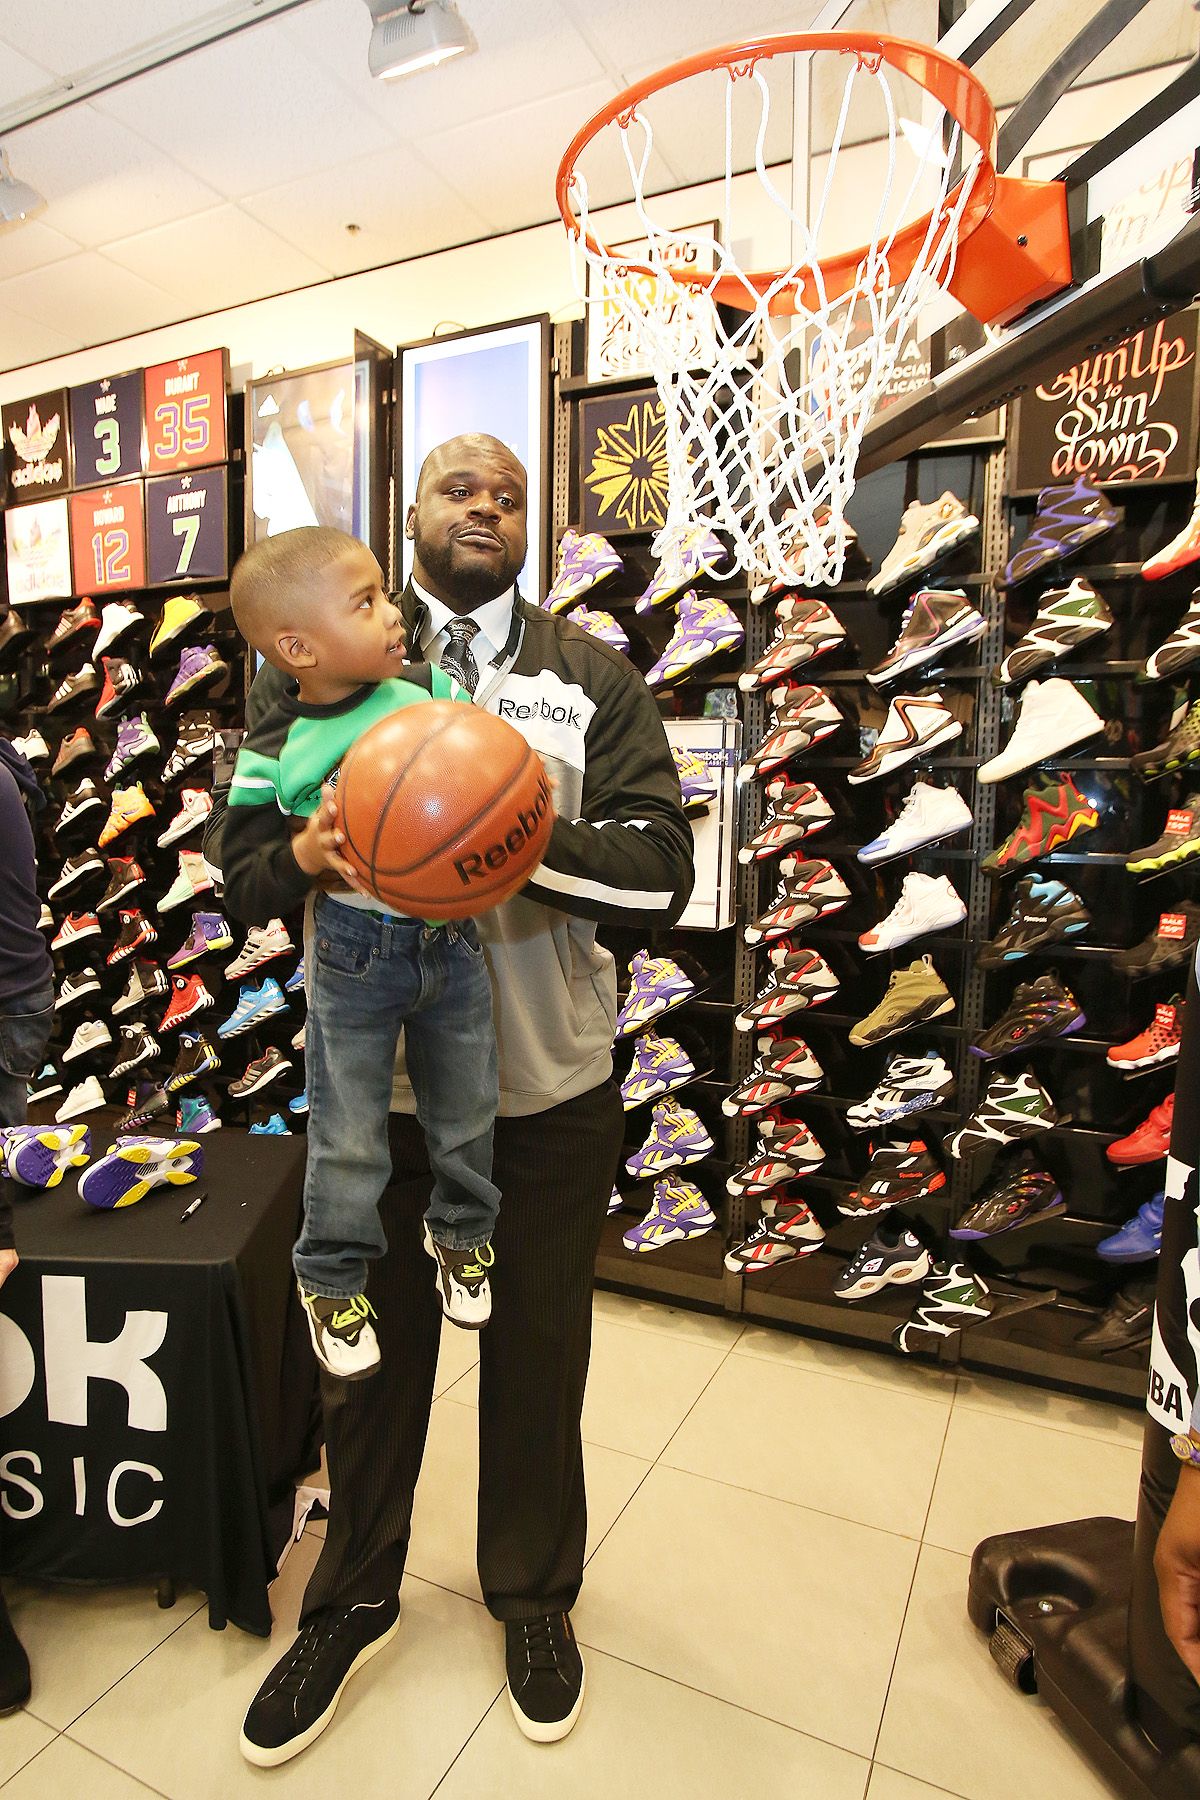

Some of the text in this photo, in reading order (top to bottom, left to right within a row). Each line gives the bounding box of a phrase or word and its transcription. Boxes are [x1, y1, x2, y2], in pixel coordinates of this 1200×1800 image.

[93, 417, 122, 476] 3
[154, 394, 211, 460] 35
[92, 528, 131, 585] 12
[172, 514, 201, 574] 7
[1147, 1365, 1184, 1422] BA
